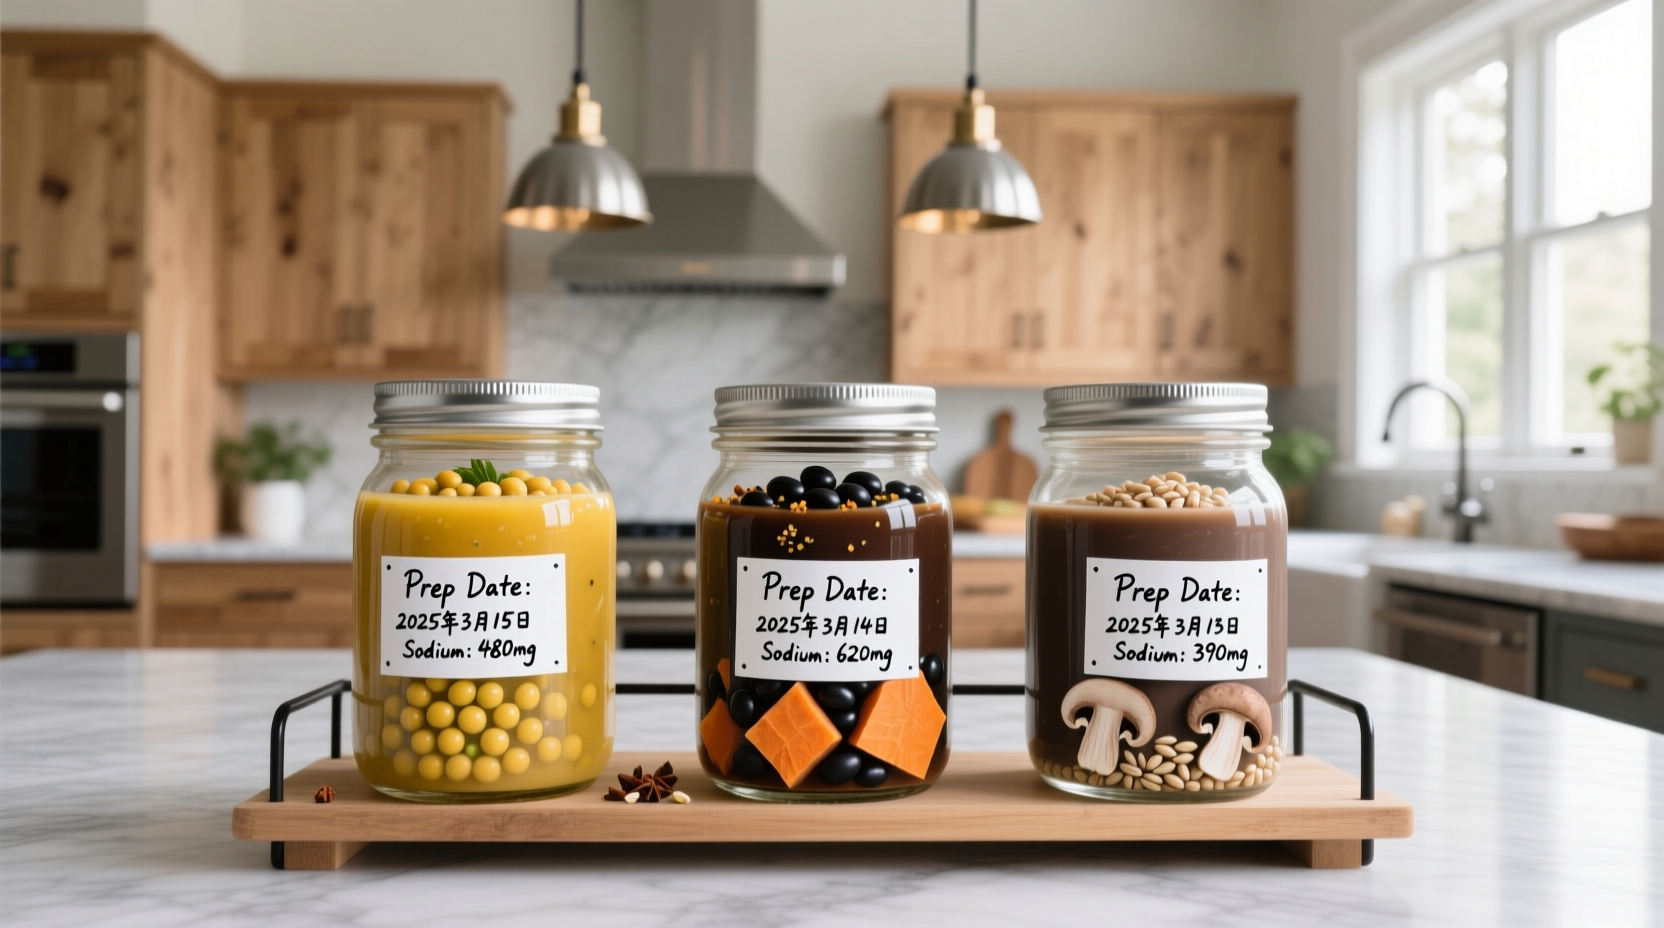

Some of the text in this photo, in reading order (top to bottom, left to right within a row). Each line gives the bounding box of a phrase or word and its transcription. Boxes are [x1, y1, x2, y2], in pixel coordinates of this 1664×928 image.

[403, 568, 531, 610] Prep Date:
[761, 570, 887, 613] Prep Date:
[1113, 572, 1240, 614] Prep Date:
[395, 609, 530, 637] 2025年3月15日
[755, 612, 888, 639] 2025年3月14日
[402, 638, 537, 667] Sodium: 480mg
[760, 640, 893, 672] Sodium: 620mg
[1113, 640, 1249, 672] Sodium: 390mg
